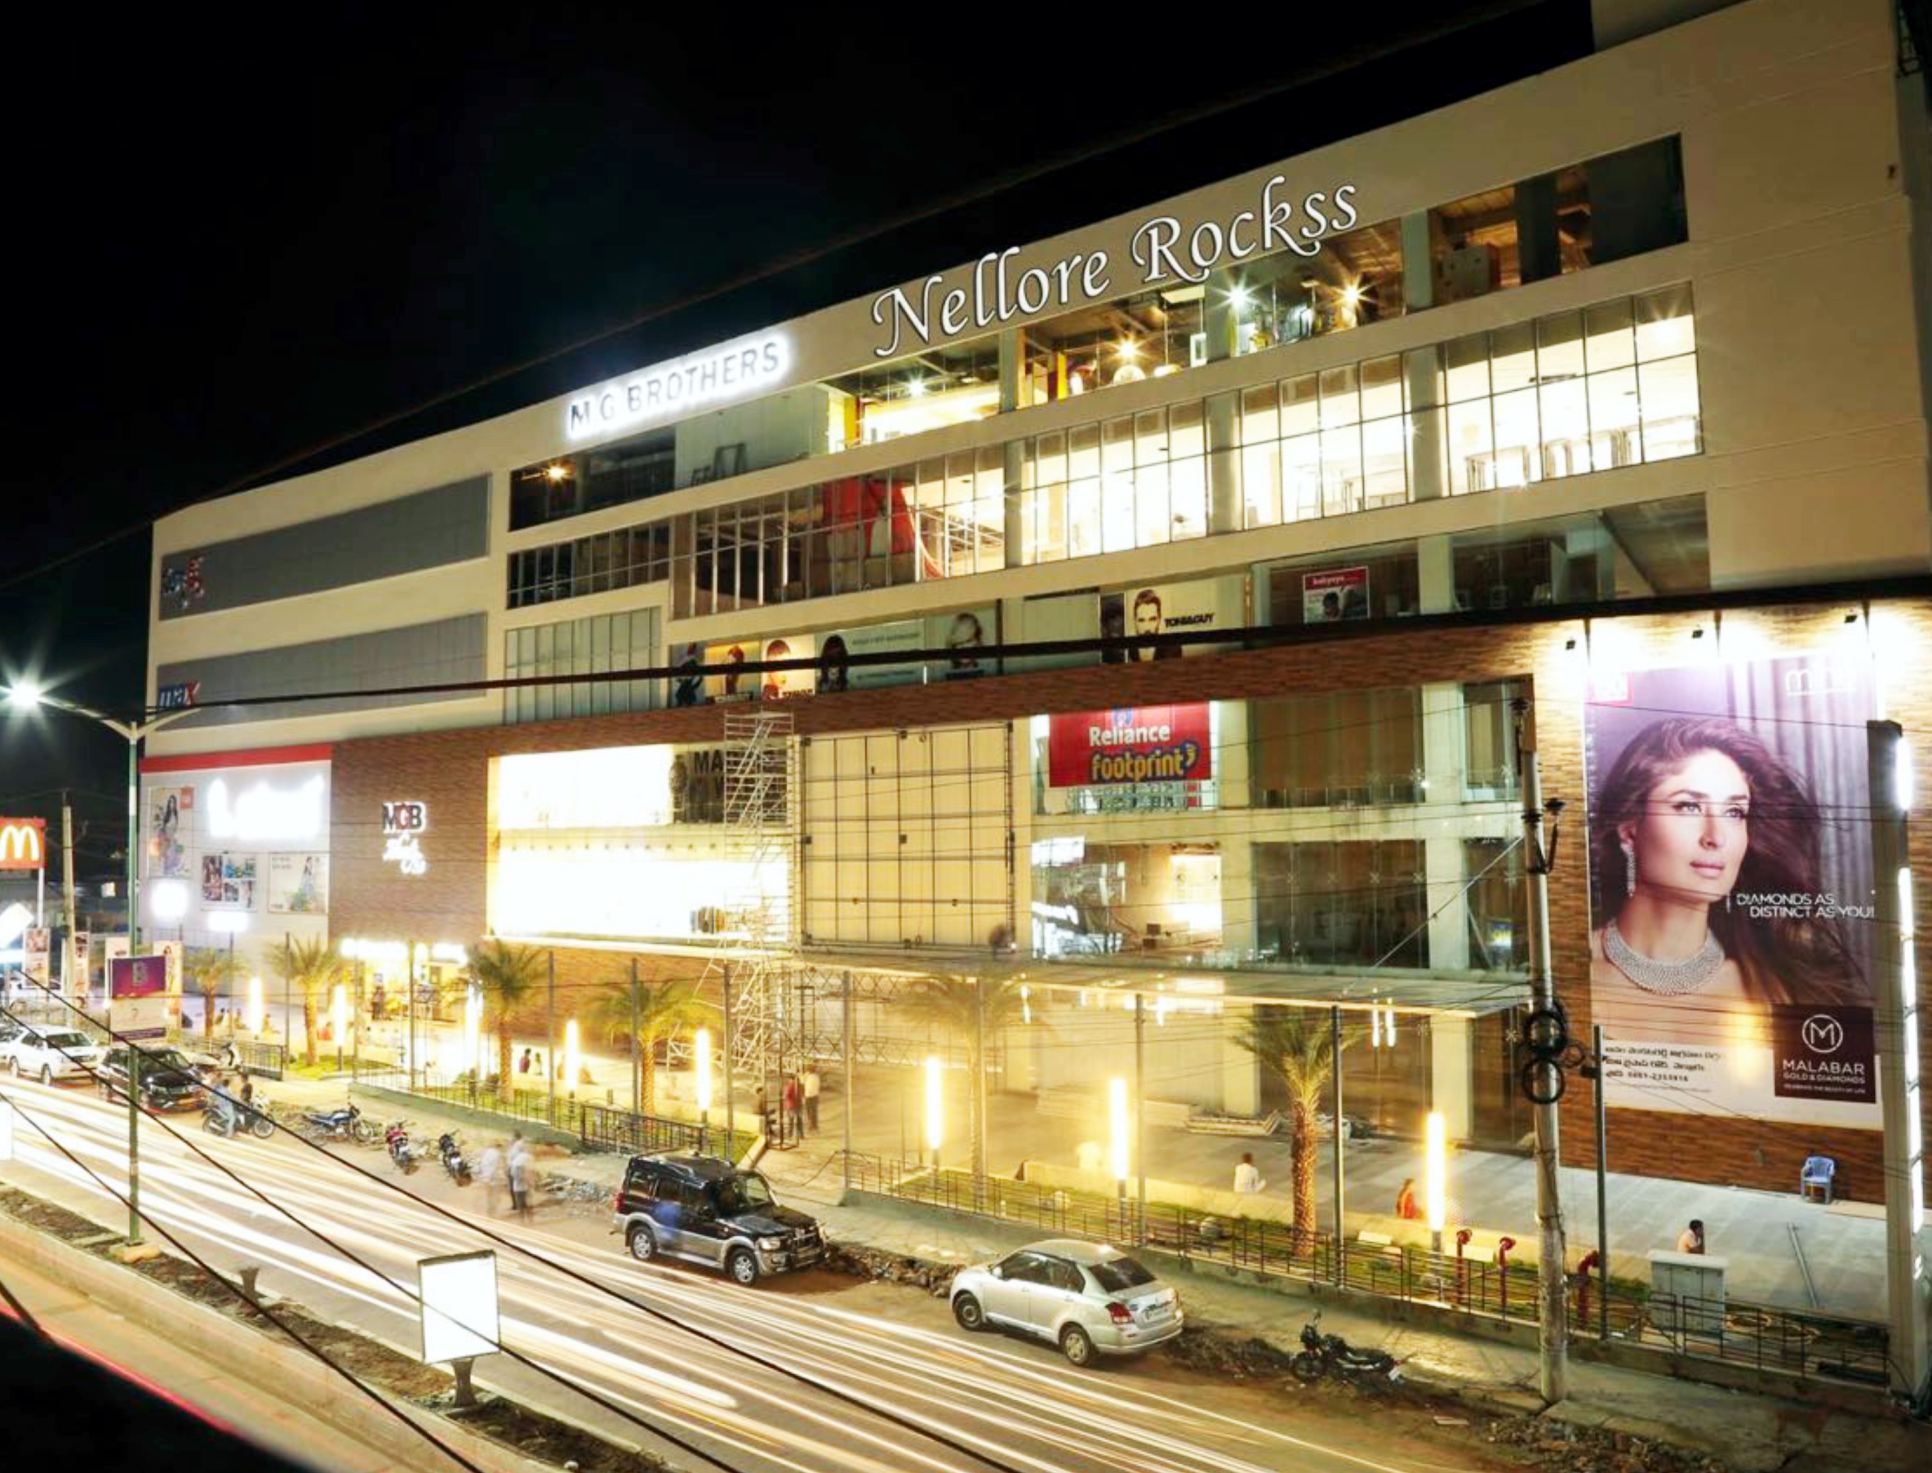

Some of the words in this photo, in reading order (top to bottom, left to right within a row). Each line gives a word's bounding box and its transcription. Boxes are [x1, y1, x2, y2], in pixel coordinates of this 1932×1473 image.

[570, 401, 591, 431] M
[626, 341, 781, 412] BROTHERS
[1088, 723, 1171, 747] Reliance
[1091, 747, 1185, 782] footprint
[1736, 893, 1812, 905] DIAMONDS
[1814, 893, 1835, 905] AS
[1750, 905, 1812, 918] DISTINCT
[1815, 905, 1836, 918] AS
[1783, 1059, 1865, 1076] MALABAR
